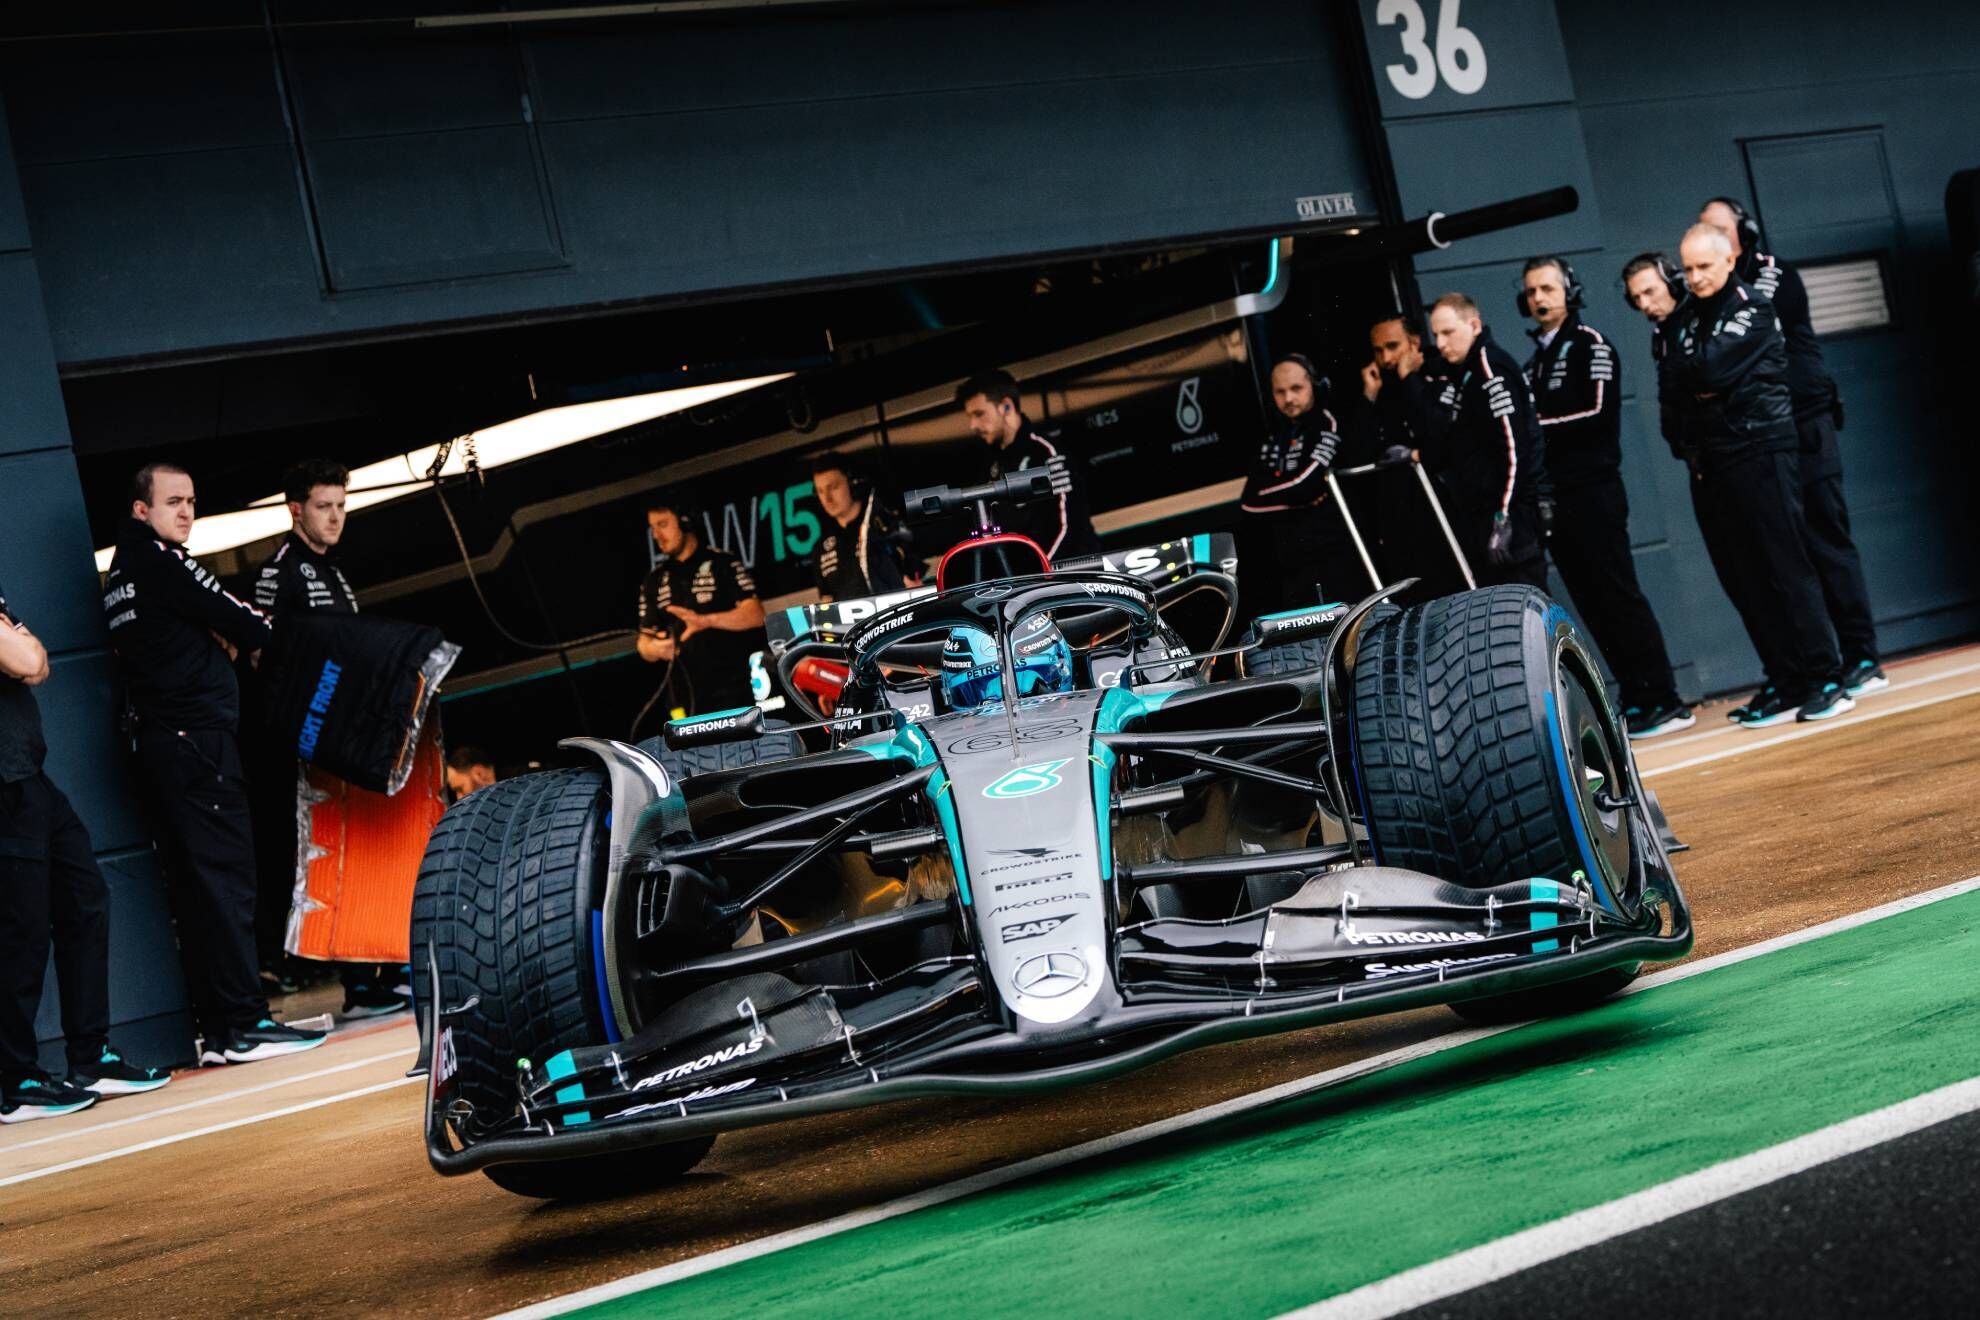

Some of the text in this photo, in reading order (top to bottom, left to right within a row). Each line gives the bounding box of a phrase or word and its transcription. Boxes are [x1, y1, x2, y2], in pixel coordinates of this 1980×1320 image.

[1376, 0, 1488, 99] 36
[1297, 195, 1357, 219] OLIVER
[1087, 583, 1146, 603] CROWDSTRIKE
[856, 612, 914, 649] CROWDSTRIKE
[1277, 612, 1335, 631] PETRONAS
[309, 659, 342, 714] FRONT
[679, 717, 737, 737] PETRONAS
[980, 853, 1082, 876] CROWDSTRIKE
[995, 872, 1073, 892] PIRELLI
[1002, 916, 1065, 943] SAP
[1347, 931, 1486, 945] PETRONAS
[632, 1037, 764, 1091] PETRONAS
